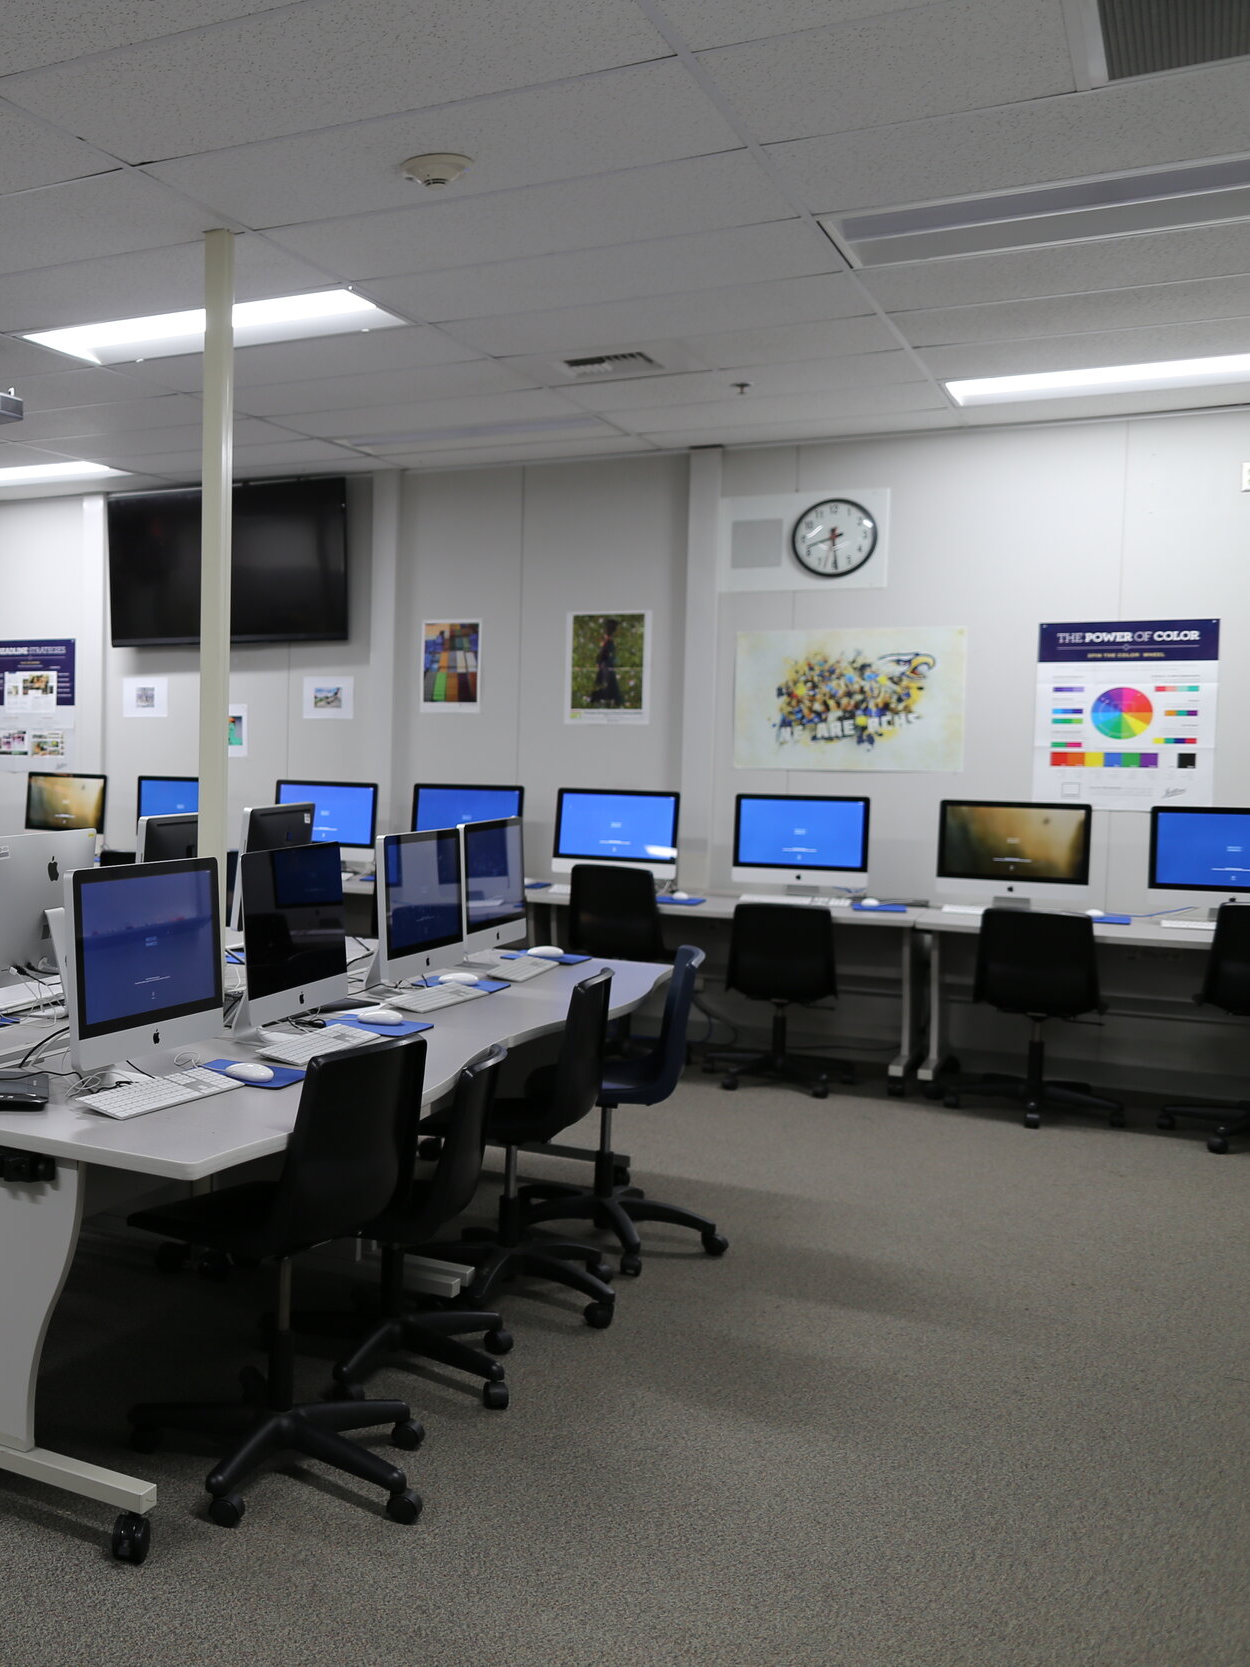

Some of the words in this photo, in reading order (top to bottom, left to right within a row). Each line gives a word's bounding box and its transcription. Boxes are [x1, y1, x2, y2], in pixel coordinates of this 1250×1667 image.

[1056, 632, 1083, 643] THE
[1084, 631, 1133, 643] POWER
[1134, 631, 1152, 642] OF
[1153, 630, 1201, 641] COLOR
[816, 718, 856, 739] ARE
